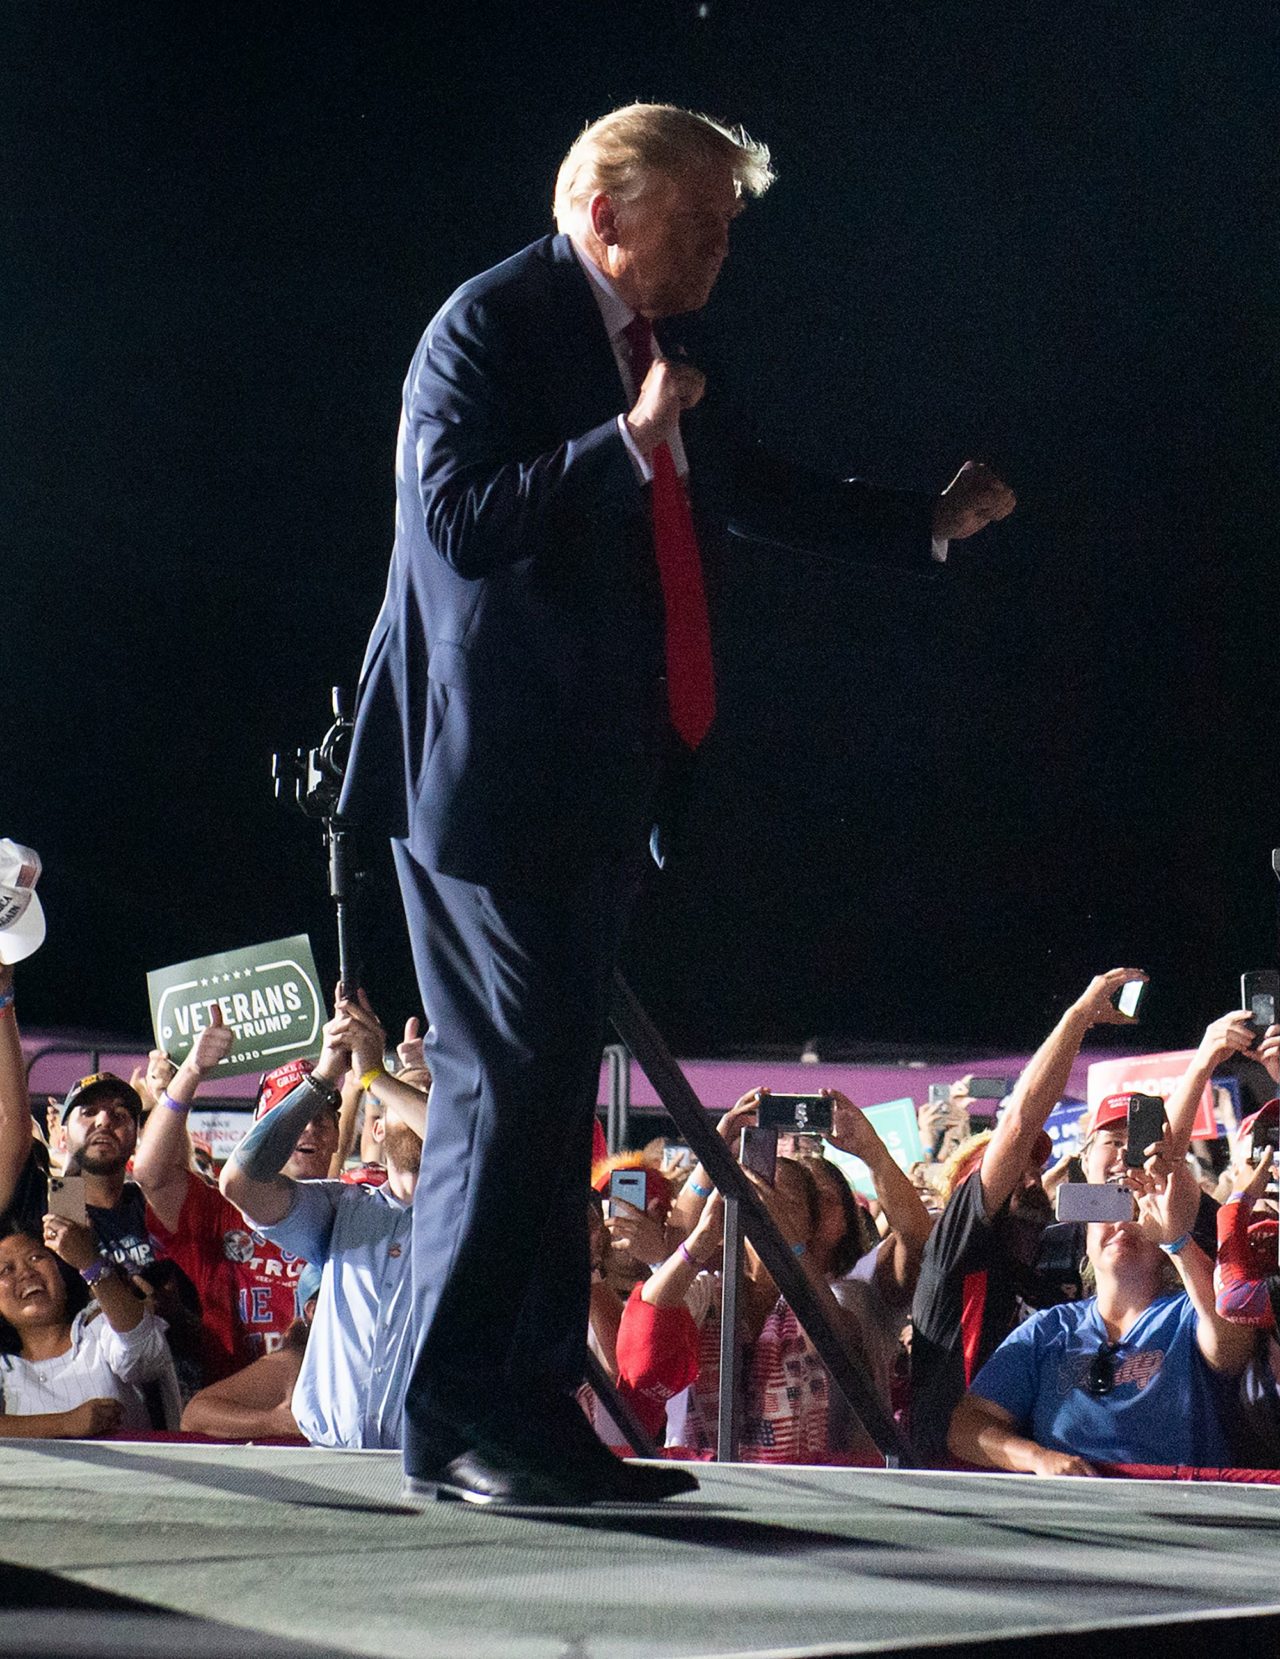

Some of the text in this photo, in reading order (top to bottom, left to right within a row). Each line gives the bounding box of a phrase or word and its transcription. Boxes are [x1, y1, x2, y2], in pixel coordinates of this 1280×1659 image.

[173, 981, 302, 1036] VETERANS
[230, 1013, 293, 1041] TRUMP
[230, 1050, 261, 1064] 2020
[276, 1071, 301, 1088] GREA
[249, 1257, 305, 1278] TRU
